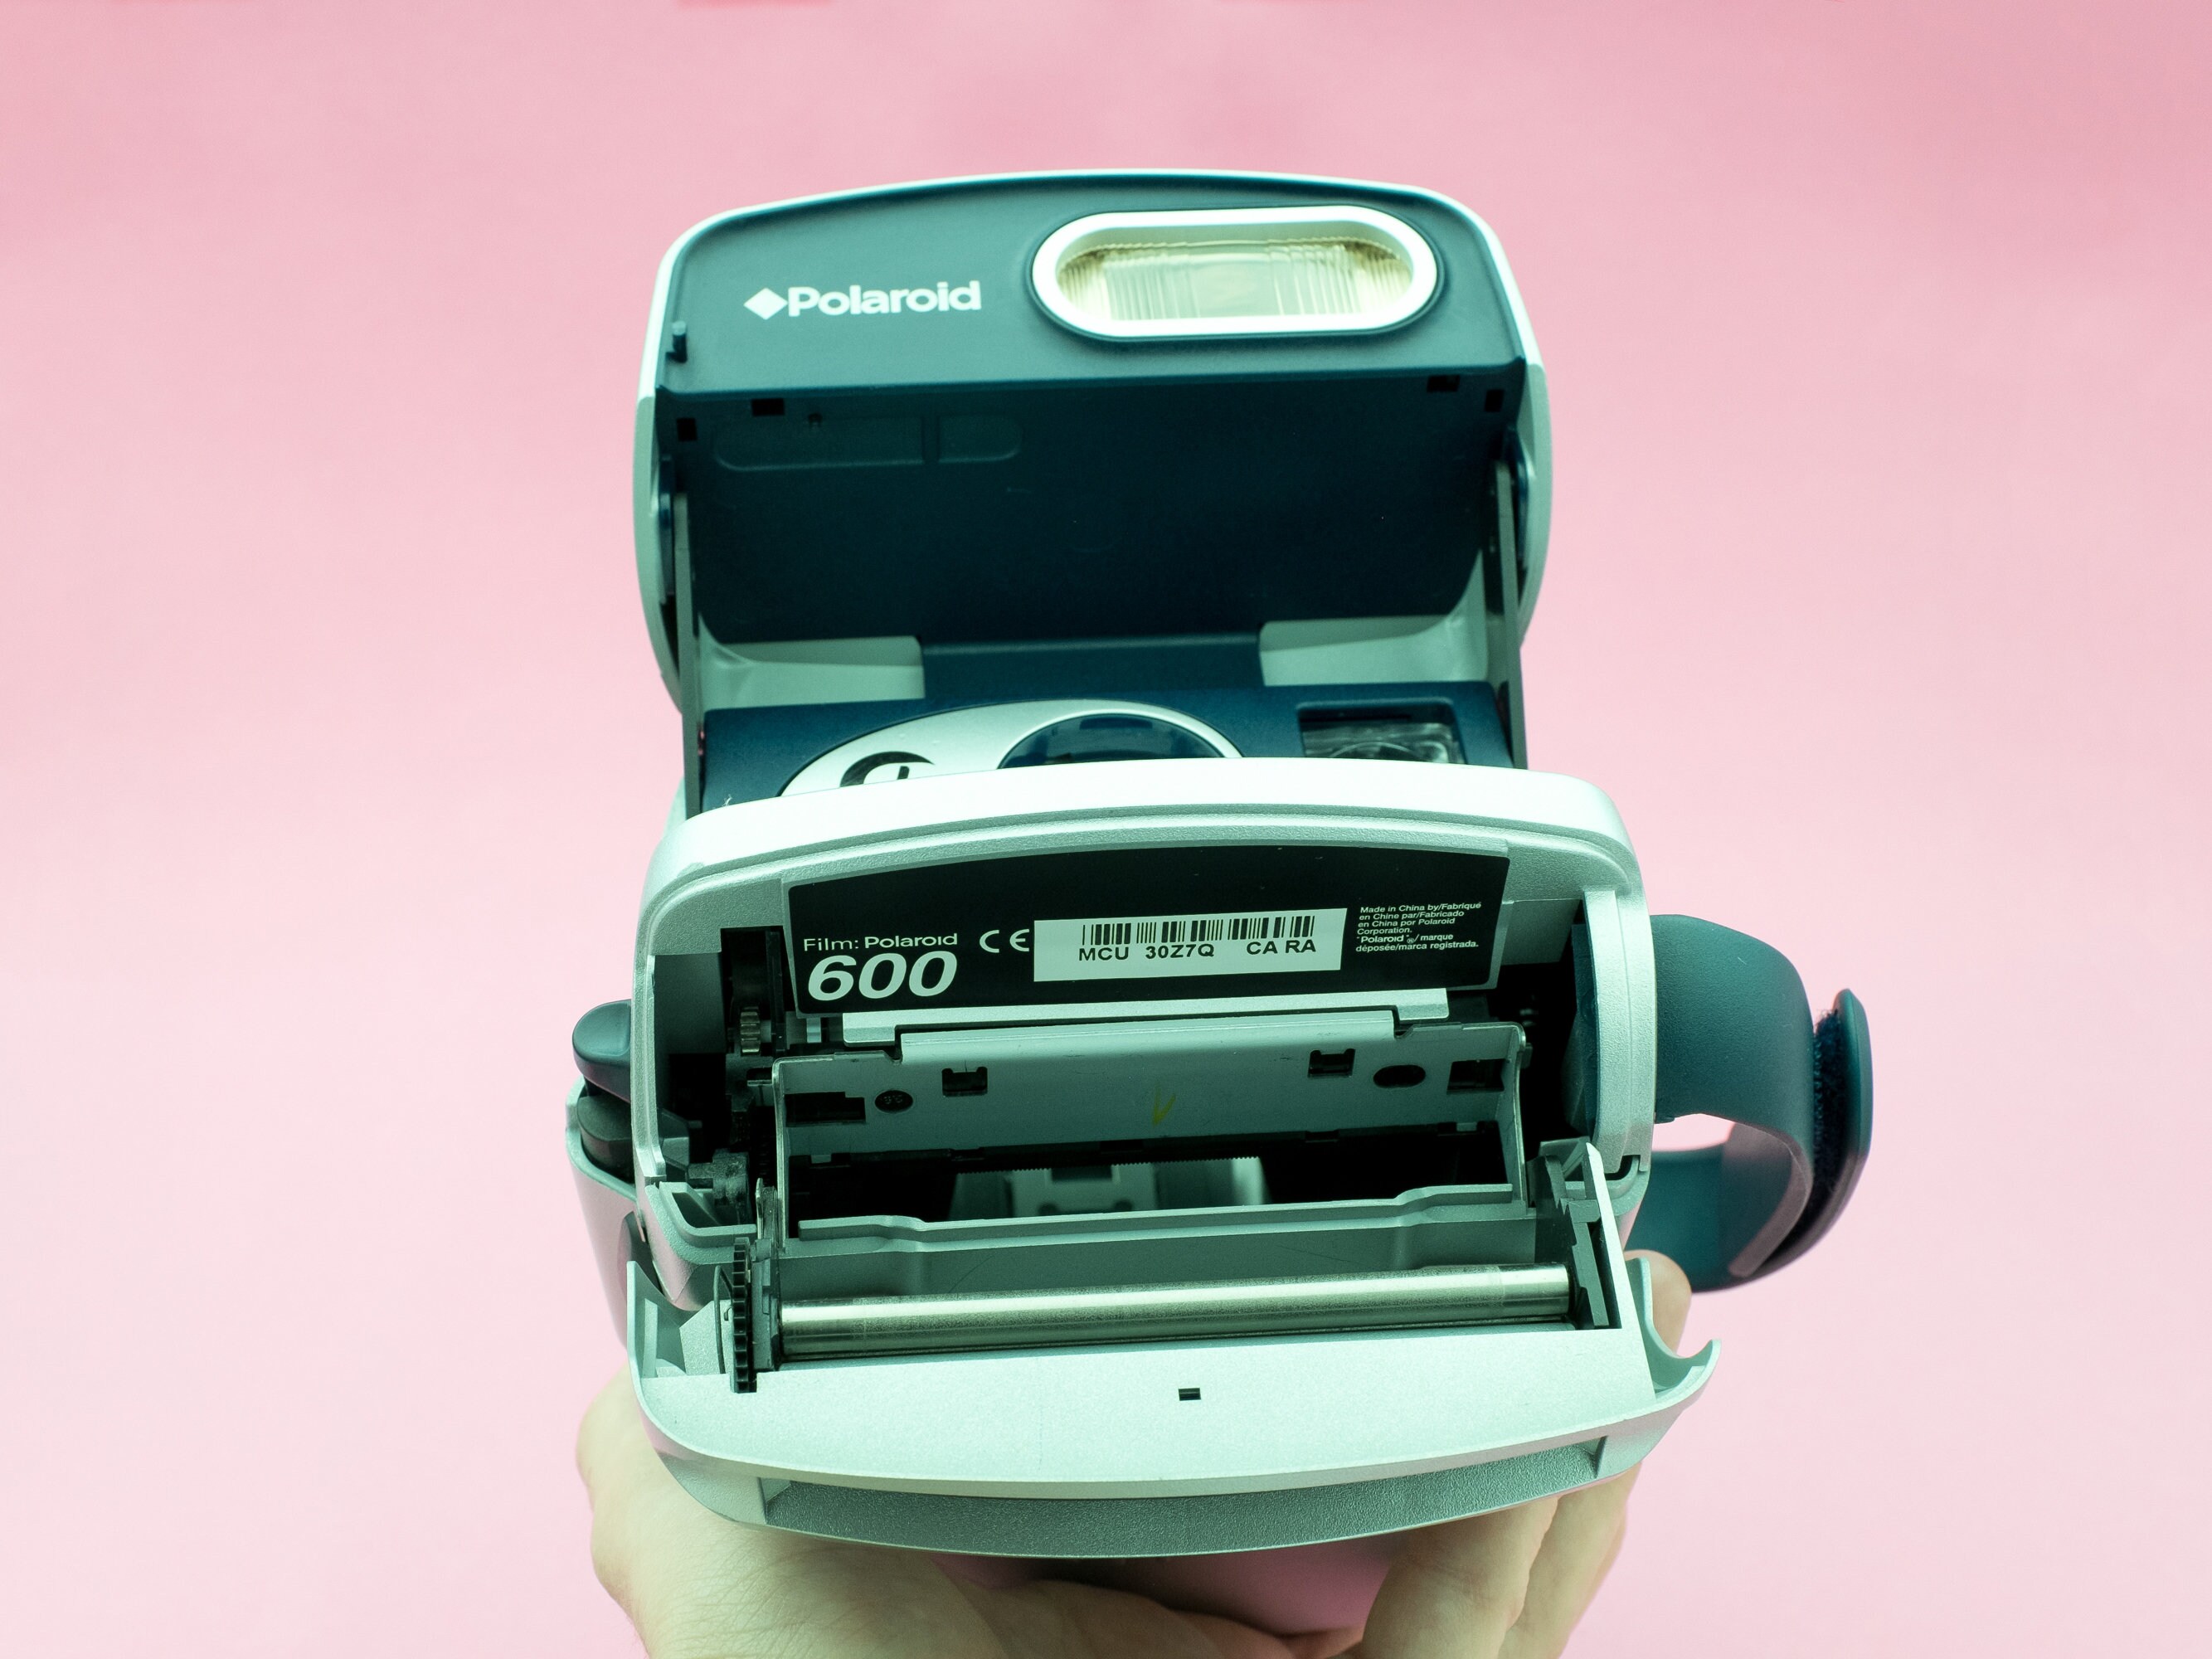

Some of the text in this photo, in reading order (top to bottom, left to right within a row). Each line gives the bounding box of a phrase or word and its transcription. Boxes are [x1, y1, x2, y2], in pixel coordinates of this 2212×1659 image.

[788, 280, 982, 317] Polaroid
[1427, 902, 1481, 912] by/Fabriqué
[1402, 911, 1465, 920] par/Fabricado
[1357, 927, 1412, 937] Corporation.
[1420, 934, 1453, 942] marque
[803, 933, 958, 951] Film: Polaroid
[979, 928, 1030, 953] CE
[1355, 941, 1479, 952] déposée/marca registrada.
[1078, 939, 1316, 961] MCU 30Z7Q CA RA
[808, 951, 958, 1001] 600
